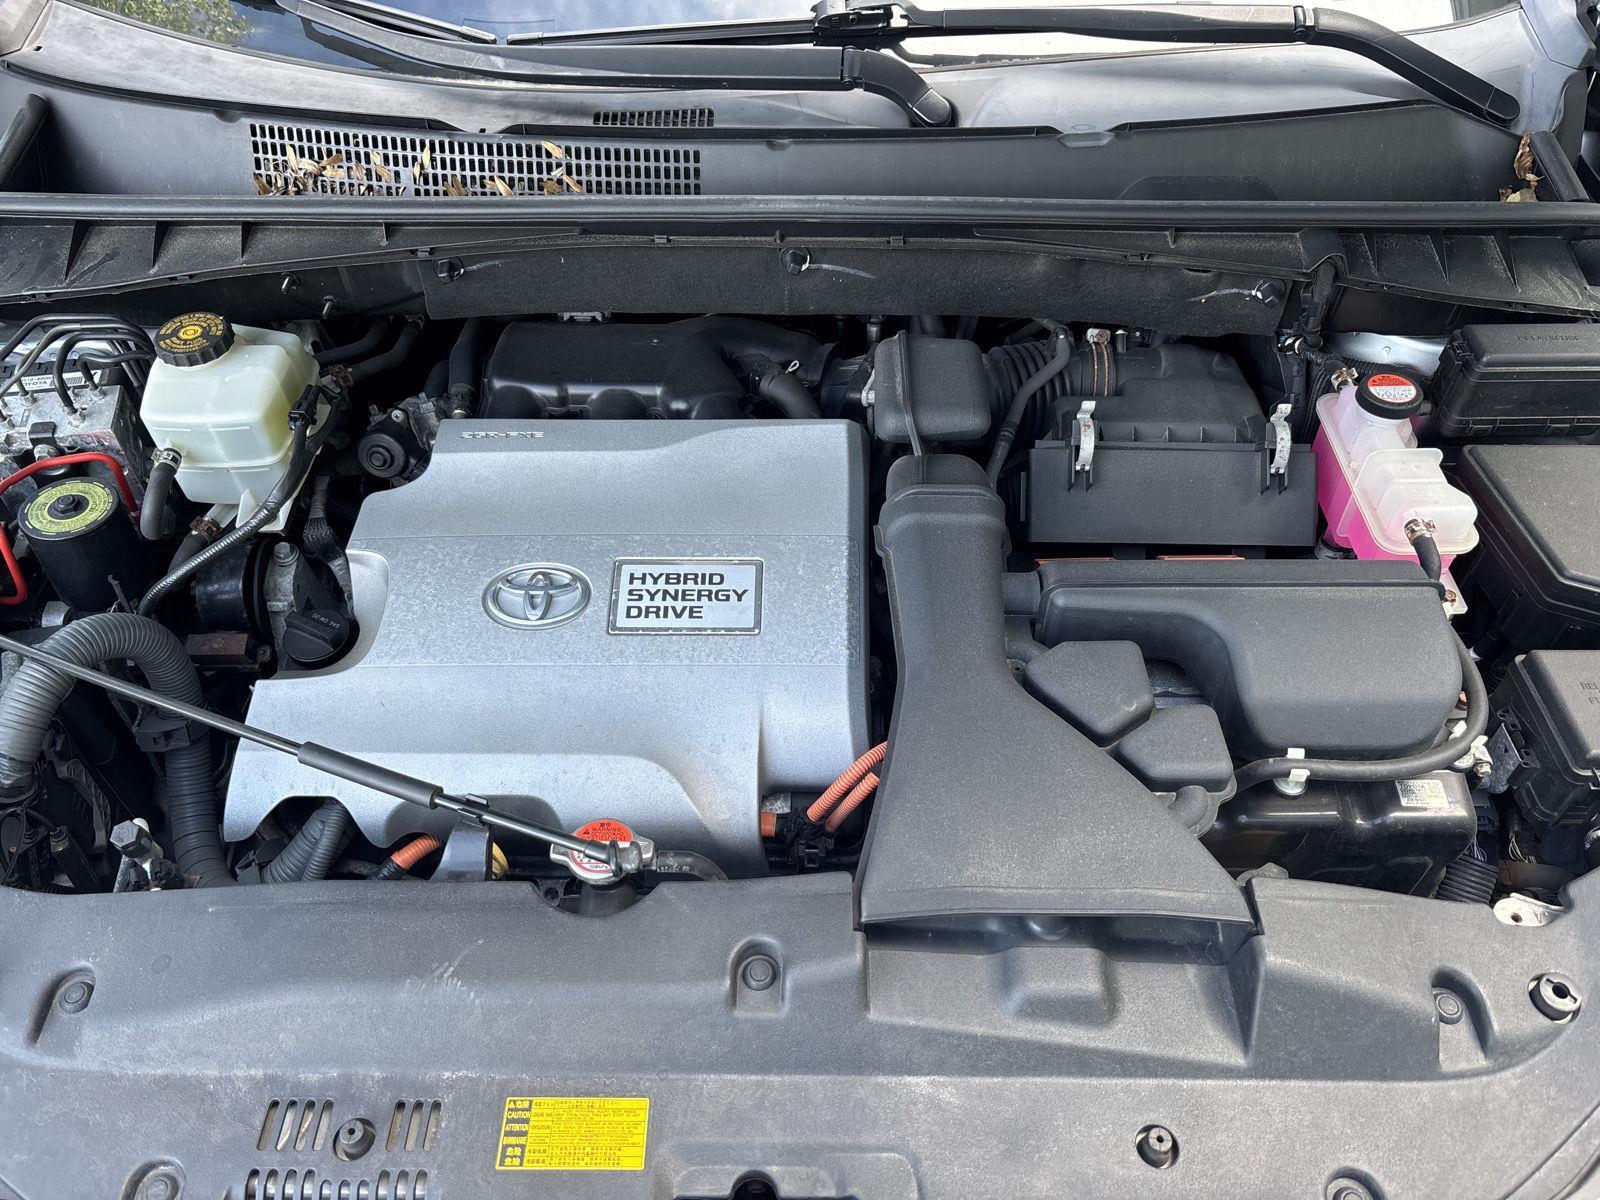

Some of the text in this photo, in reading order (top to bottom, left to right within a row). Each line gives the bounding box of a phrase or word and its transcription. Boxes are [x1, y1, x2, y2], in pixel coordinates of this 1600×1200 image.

[628, 572, 726, 586] HYBRID
[626, 589, 749, 602] SYNERGY
[625, 605, 704, 619] DRIVE
[508, 1111, 531, 1119] CAUTION
